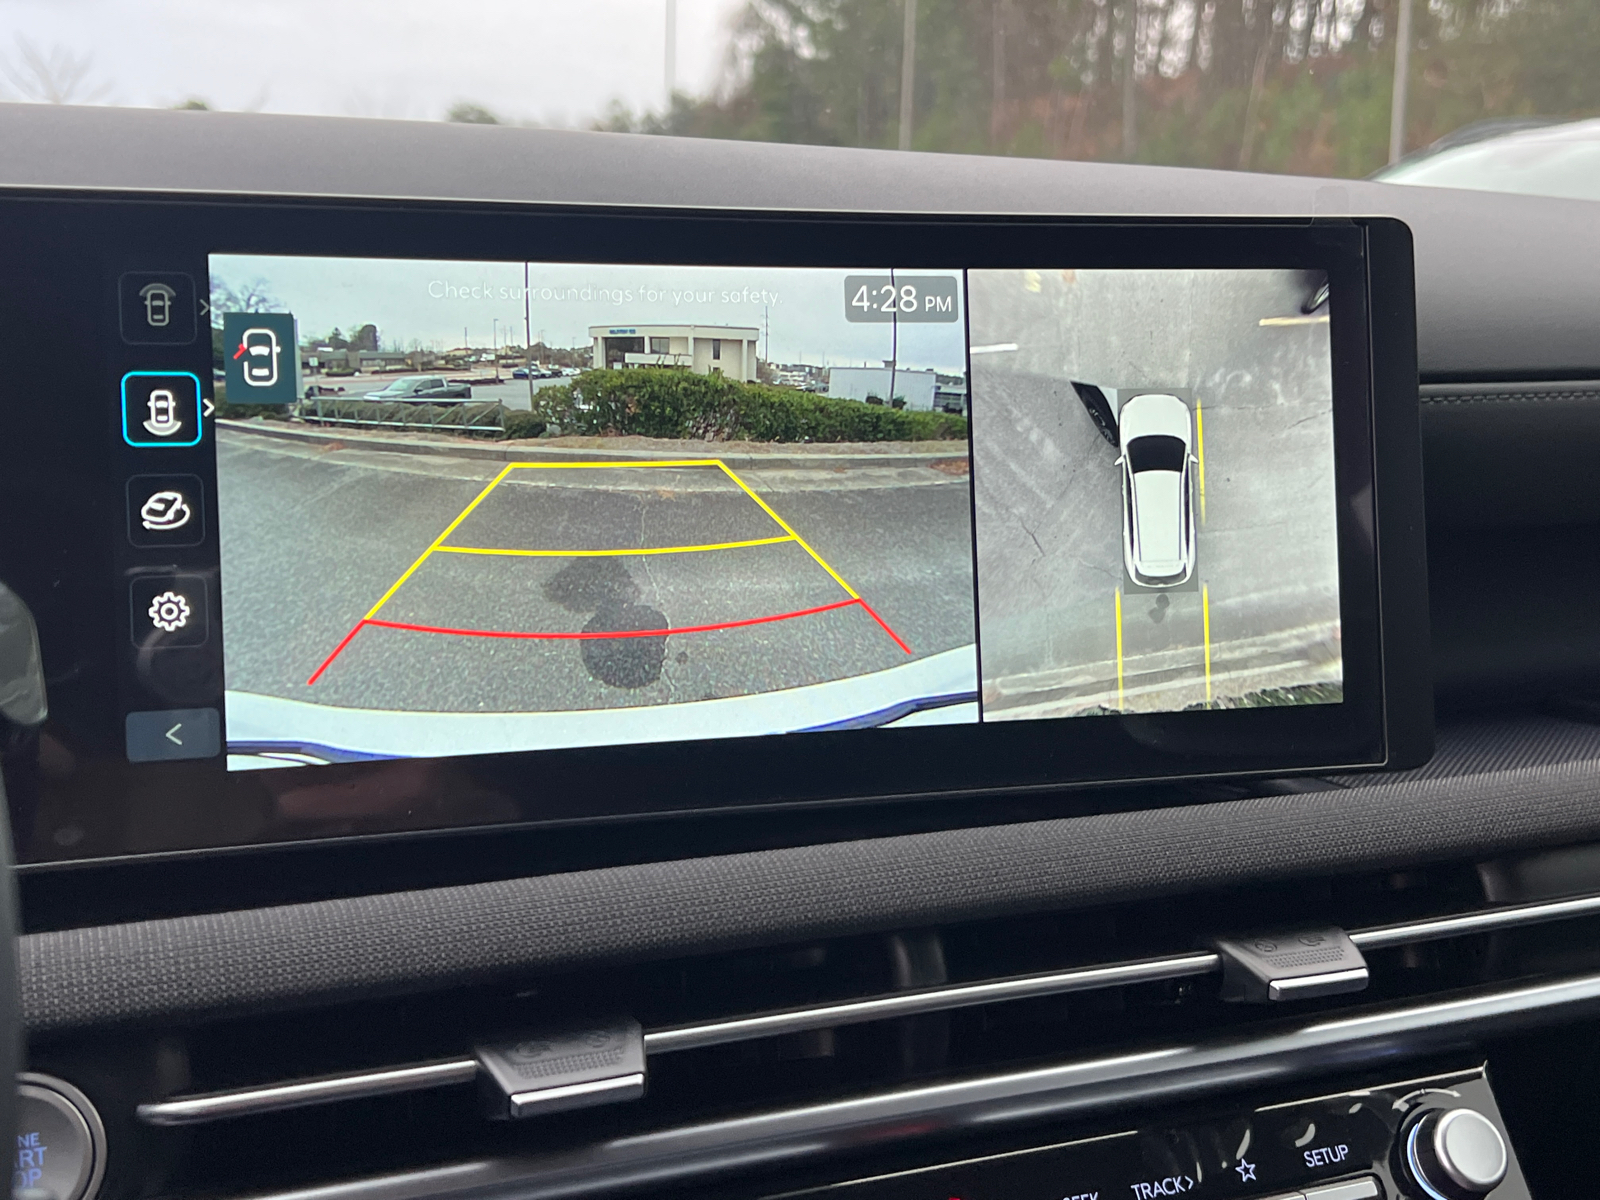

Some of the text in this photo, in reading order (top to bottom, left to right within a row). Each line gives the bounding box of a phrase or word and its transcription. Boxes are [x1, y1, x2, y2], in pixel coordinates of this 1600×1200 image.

[428, 280, 783, 307] Check surroundings for your safety.
[851, 284, 952, 313] 4:28 PM
[1303, 1144, 1349, 1168] SETUP
